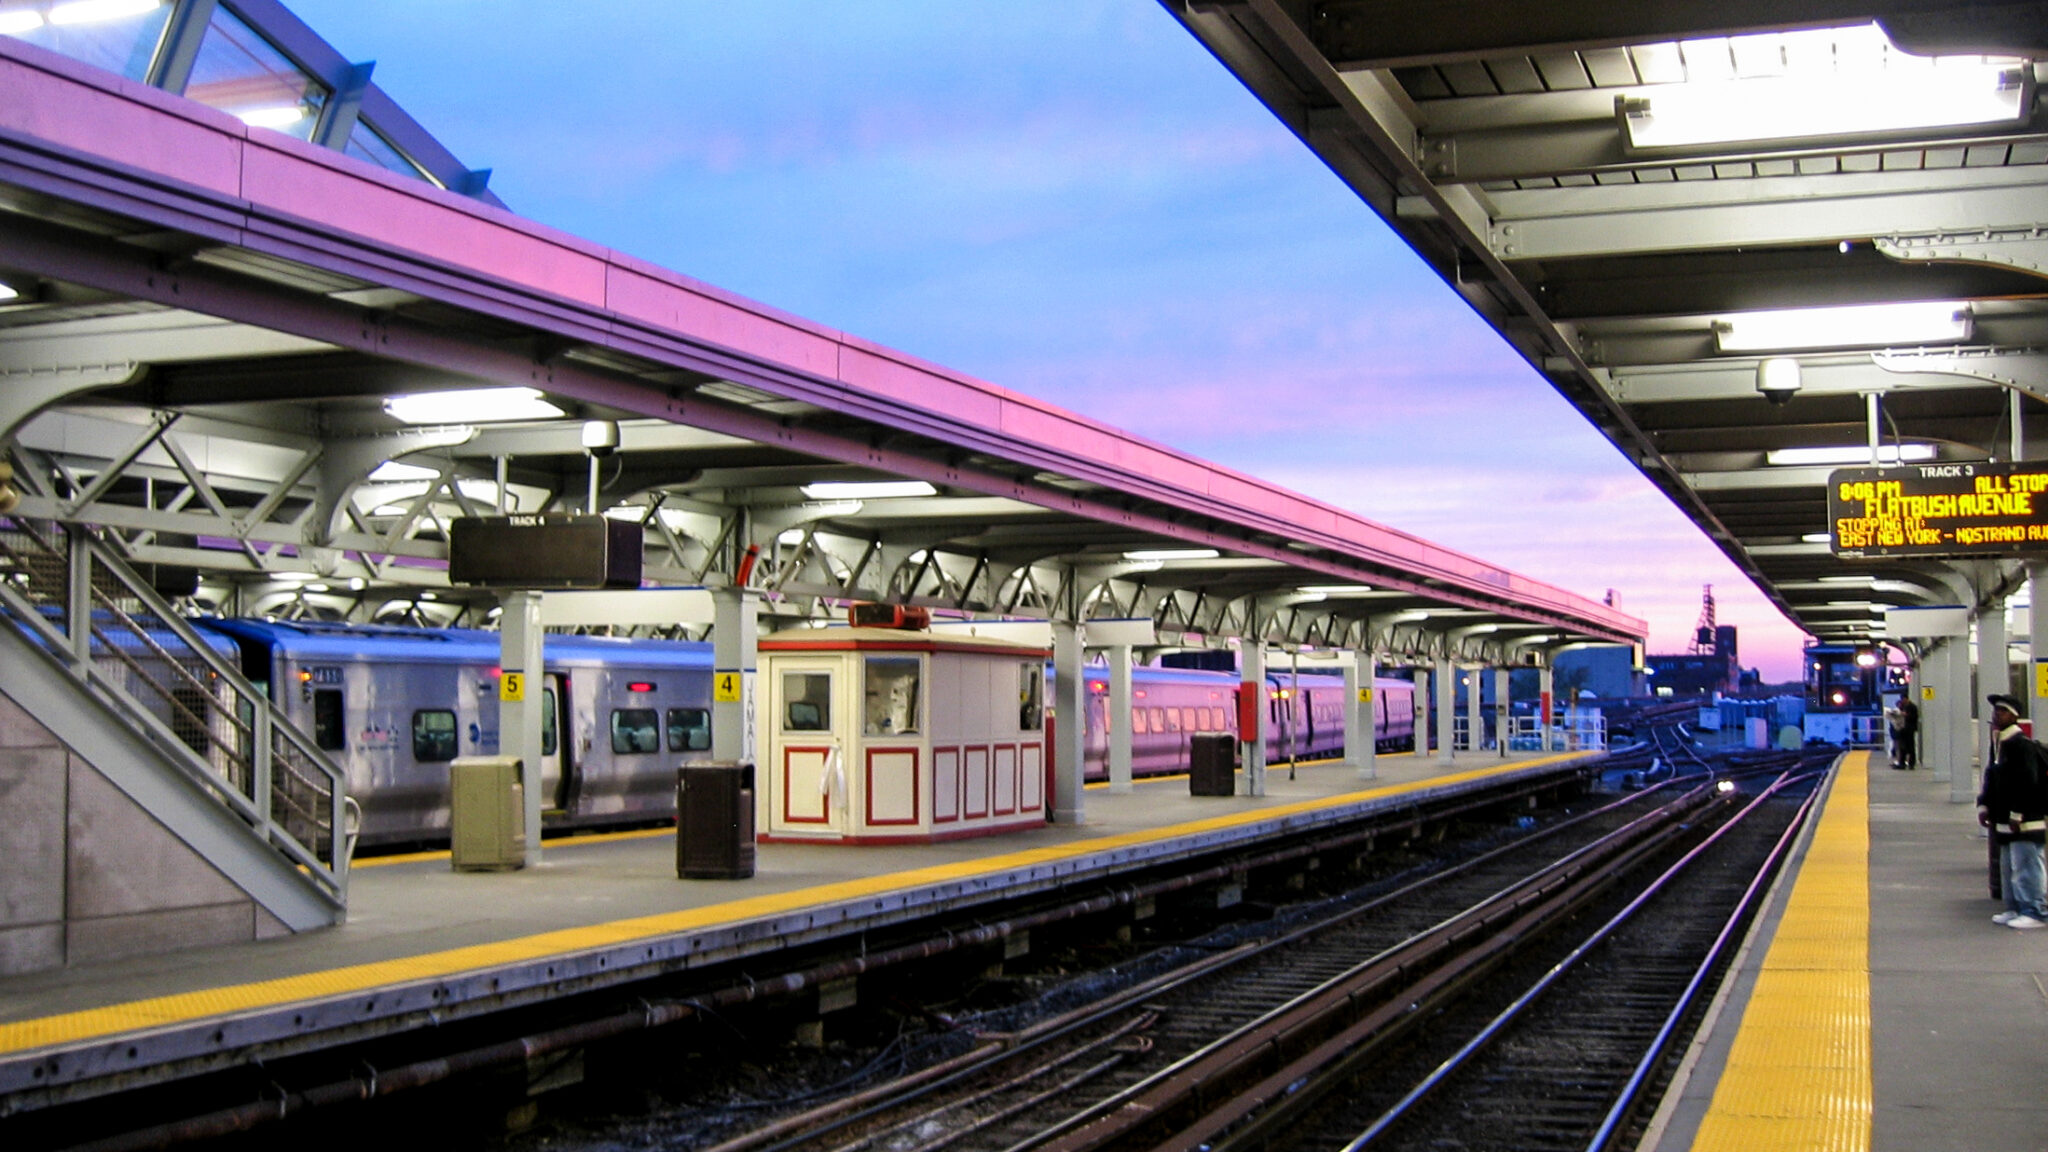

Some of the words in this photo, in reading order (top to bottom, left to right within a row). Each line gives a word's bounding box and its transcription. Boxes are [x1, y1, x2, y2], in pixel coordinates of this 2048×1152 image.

[1920, 466, 1961, 478] TRACK
[1965, 465, 1974, 476] 3
[1840, 482, 1874, 500] 8:06
[1877, 481, 1900, 498] PM
[1975, 475, 2006, 493] ALL
[1865, 495, 1957, 518] FLATBUSH
[1958, 492, 2032, 516] AVENUE
[509, 516, 537, 526] TRACK
[1837, 517, 1902, 534] STOPPING
[1838, 530, 1873, 547] EAST
[1877, 528, 1904, 546] NEW
[1906, 528, 1941, 545] YORK
[1956, 526, 2026, 544] NOSTRAND
[2028, 525, 2048, 540] AV
[507, 675, 518, 693] 5
[722, 675, 732, 693] 4
